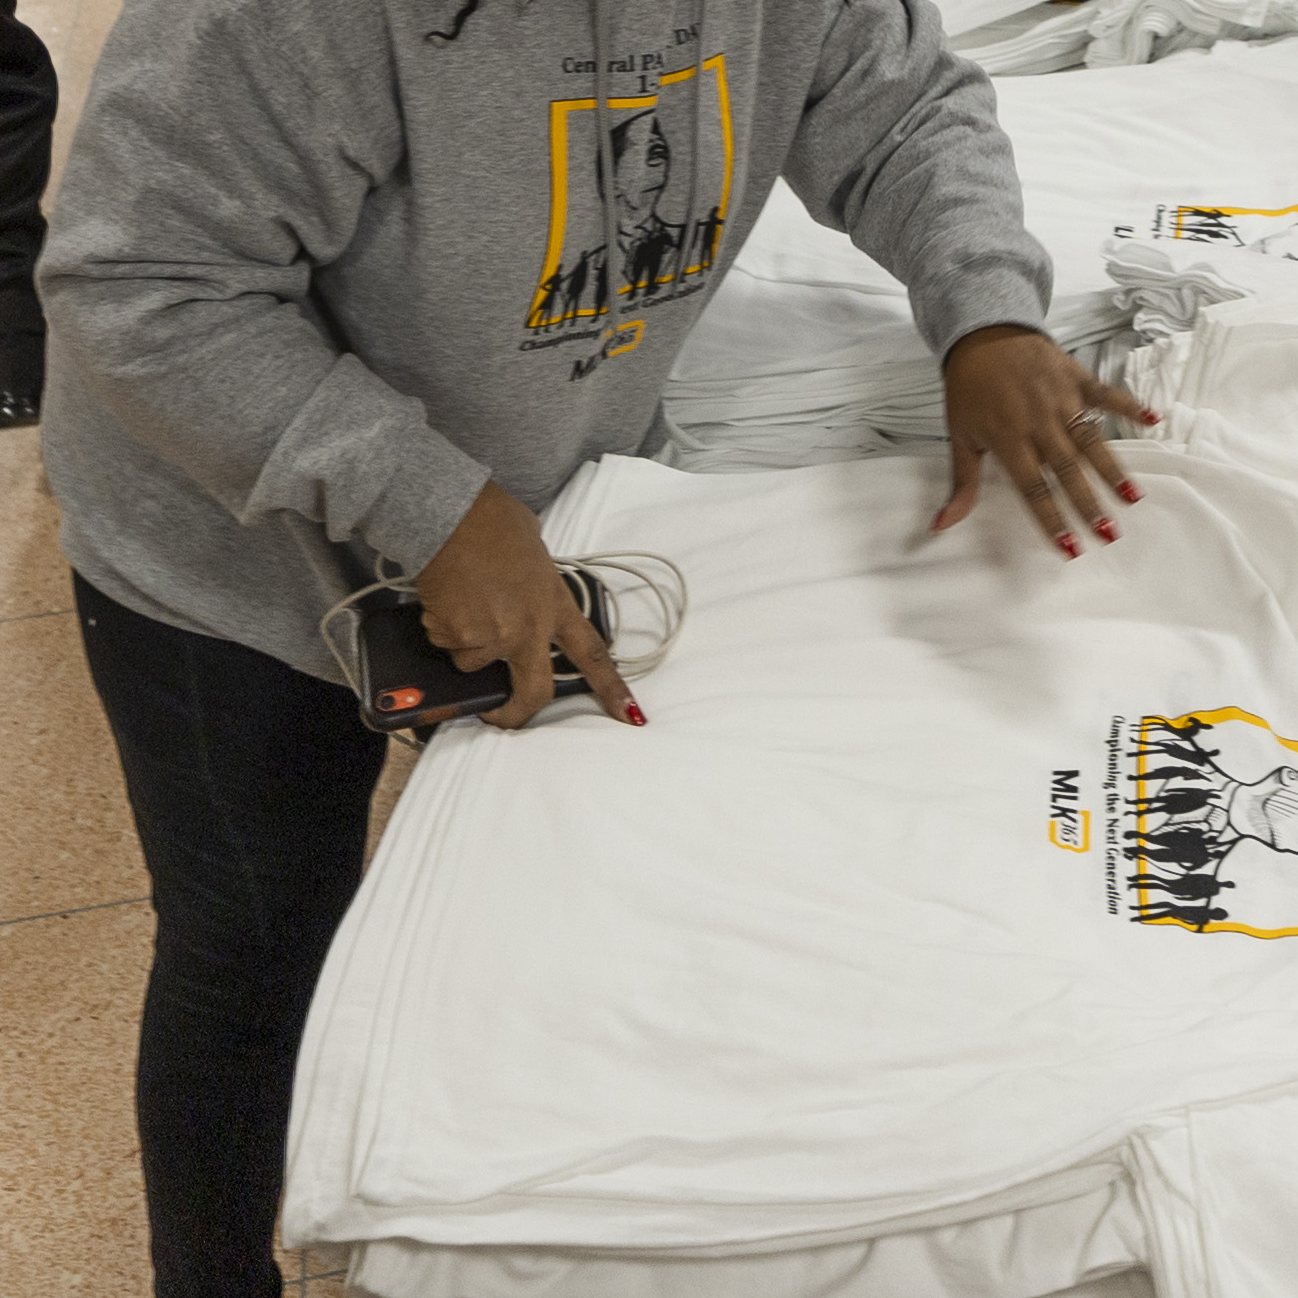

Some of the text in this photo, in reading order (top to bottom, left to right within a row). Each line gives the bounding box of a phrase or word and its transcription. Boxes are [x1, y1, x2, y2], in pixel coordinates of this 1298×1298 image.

[562, 54, 636, 74] Cenral
[1105, 793, 1122, 814] the
[1105, 818, 1122, 845] Next
[1105, 847, 1123, 915] Generation
